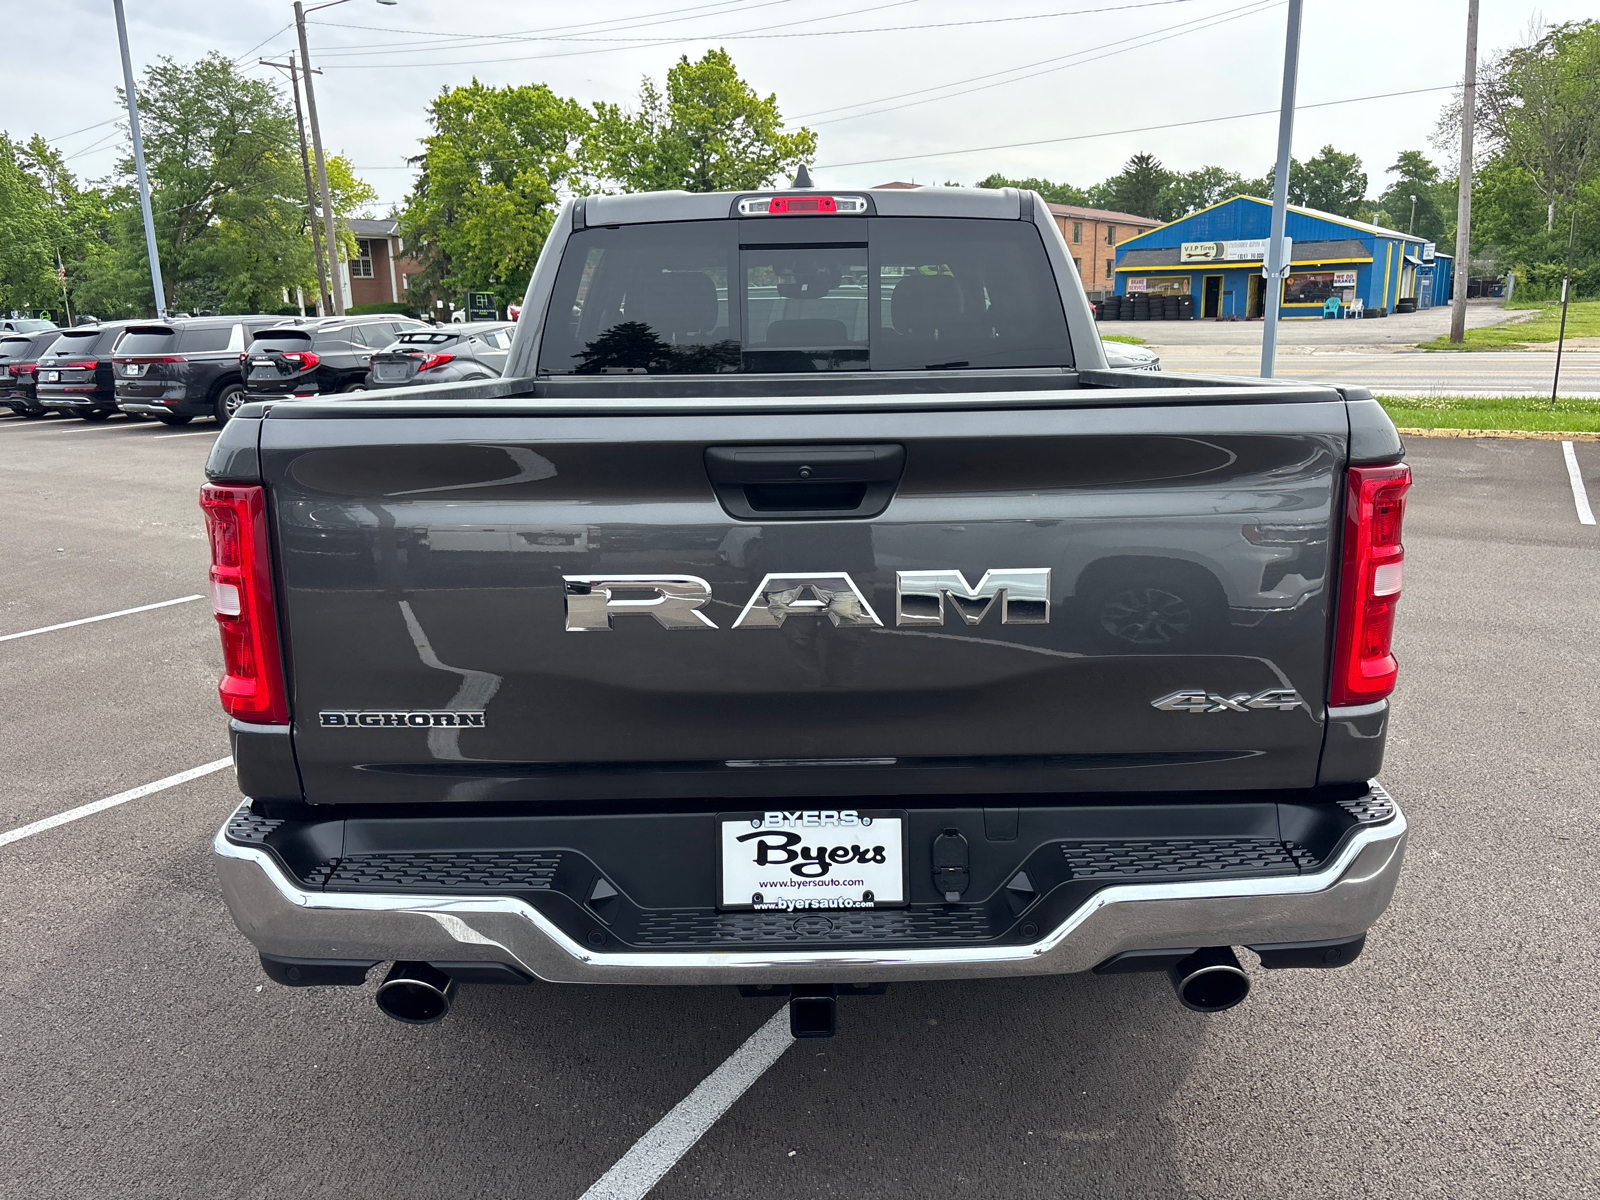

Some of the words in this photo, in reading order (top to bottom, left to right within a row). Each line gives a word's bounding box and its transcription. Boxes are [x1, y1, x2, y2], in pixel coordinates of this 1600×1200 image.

[562, 568, 1052, 631] RAM
[1150, 688, 1303, 713] 4x4
[318, 709, 486, 728] BIGHORN
[764, 810, 860, 828] BYERS
[736, 830, 886, 878] Byers
[758, 878, 864, 889] www.byersauto.com
[754, 896, 875, 912] www.byersauto.com
